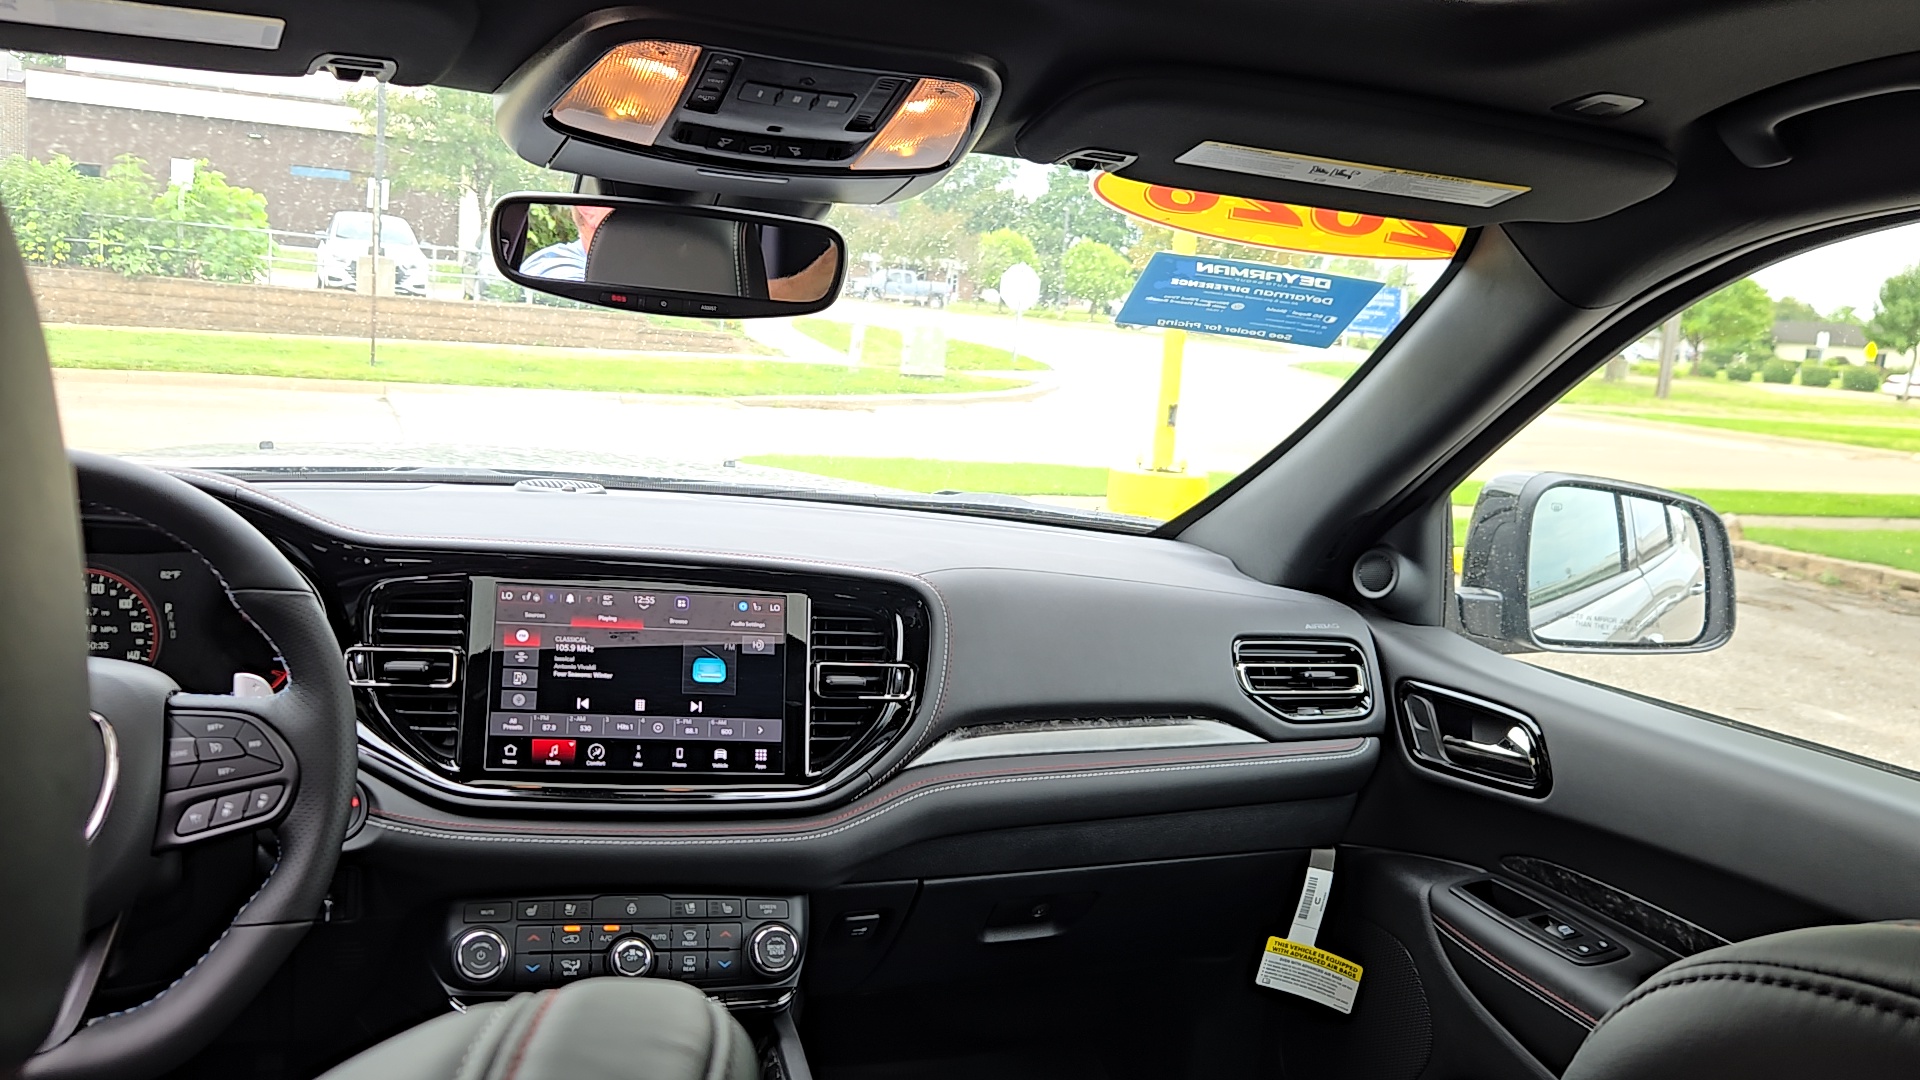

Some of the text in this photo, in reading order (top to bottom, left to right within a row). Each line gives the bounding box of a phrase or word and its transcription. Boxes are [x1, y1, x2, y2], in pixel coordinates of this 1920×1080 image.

[91, 583, 105, 594] 80
[501, 591, 514, 601] LO
[633, 595, 656, 605] 12:55
[118, 599, 133, 609] 100
[164, 602, 173, 614] P
[769, 604, 781, 612] LO
[524, 611, 546, 619] Sources
[597, 614, 618, 623] Playing
[669, 617, 689, 625] Browse
[745, 621, 766, 629] Settings
[130, 622, 145, 632] 120
[554, 635, 587, 643] CLASSICAL
[555, 643, 595, 653] 105.9 MHz
[724, 643, 736, 651] FM
[126, 650, 141, 660] 140
[553, 670, 568, 678] Four
[1274, 940, 1358, 973] THIS VEHICLE IS EQUIPPED
[1272, 946, 1289, 955] WITH
[1290, 950, 1326, 966] ADVANCED
[1326, 961, 1338, 970] AIR
[1338, 966, 1357, 978] BAGS
